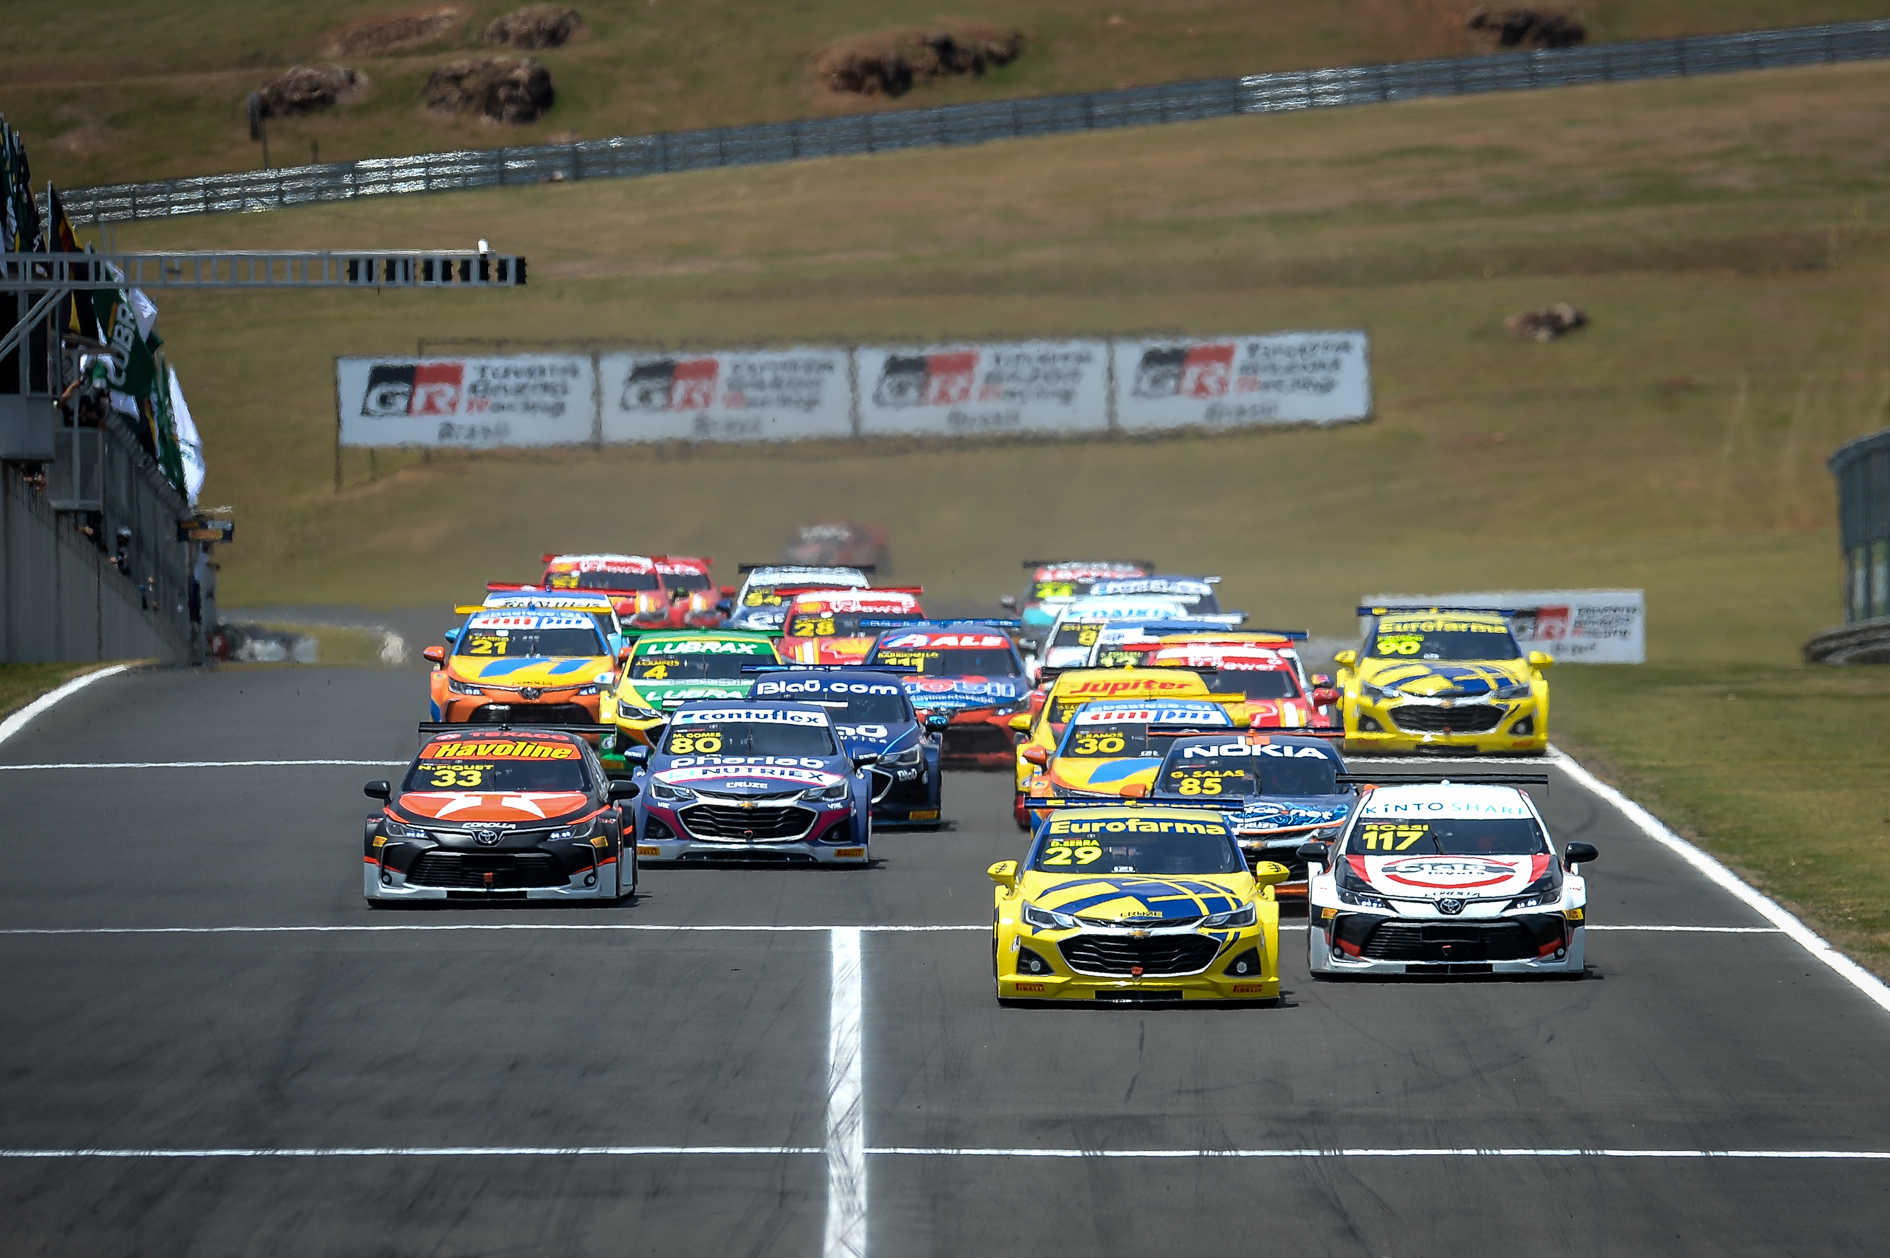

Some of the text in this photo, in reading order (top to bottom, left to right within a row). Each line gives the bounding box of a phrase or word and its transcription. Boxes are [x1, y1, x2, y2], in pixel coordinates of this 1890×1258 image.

[794, 622, 835, 637] 28
[1378, 620, 1508, 634] Eurofarma
[469, 640, 509, 655] 21
[647, 640, 758, 654] LUBRAX
[930, 635, 1001, 647] ALE
[1377, 640, 1421, 655] 90
[642, 665, 668, 680] 4
[645, 689, 743, 701] LUBRA
[700, 710, 819, 724] contuflex
[469, 731, 570, 741] TEXACO
[435, 741, 573, 759] Havoline
[670, 738, 722, 754] 80
[1074, 738, 1125, 755] 30
[1184, 744, 1328, 760] NOKIA
[430, 770, 482, 787] 33
[701, 767, 825, 782] NUTRIEX
[1192, 769, 1246, 778] SALAS
[1178, 777, 1222, 796] 85
[1452, 802, 1528, 815] SHARE
[461, 822, 516, 831] COROLLA
[1050, 818, 1227, 835] Eurofarma
[1050, 839, 1100, 847] D.SERRA
[1362, 831, 1424, 851] 117
[1043, 846, 1103, 866] 29
[1015, 983, 1045, 993] PIRELLI
[1233, 984, 1263, 993] PIRELLI
